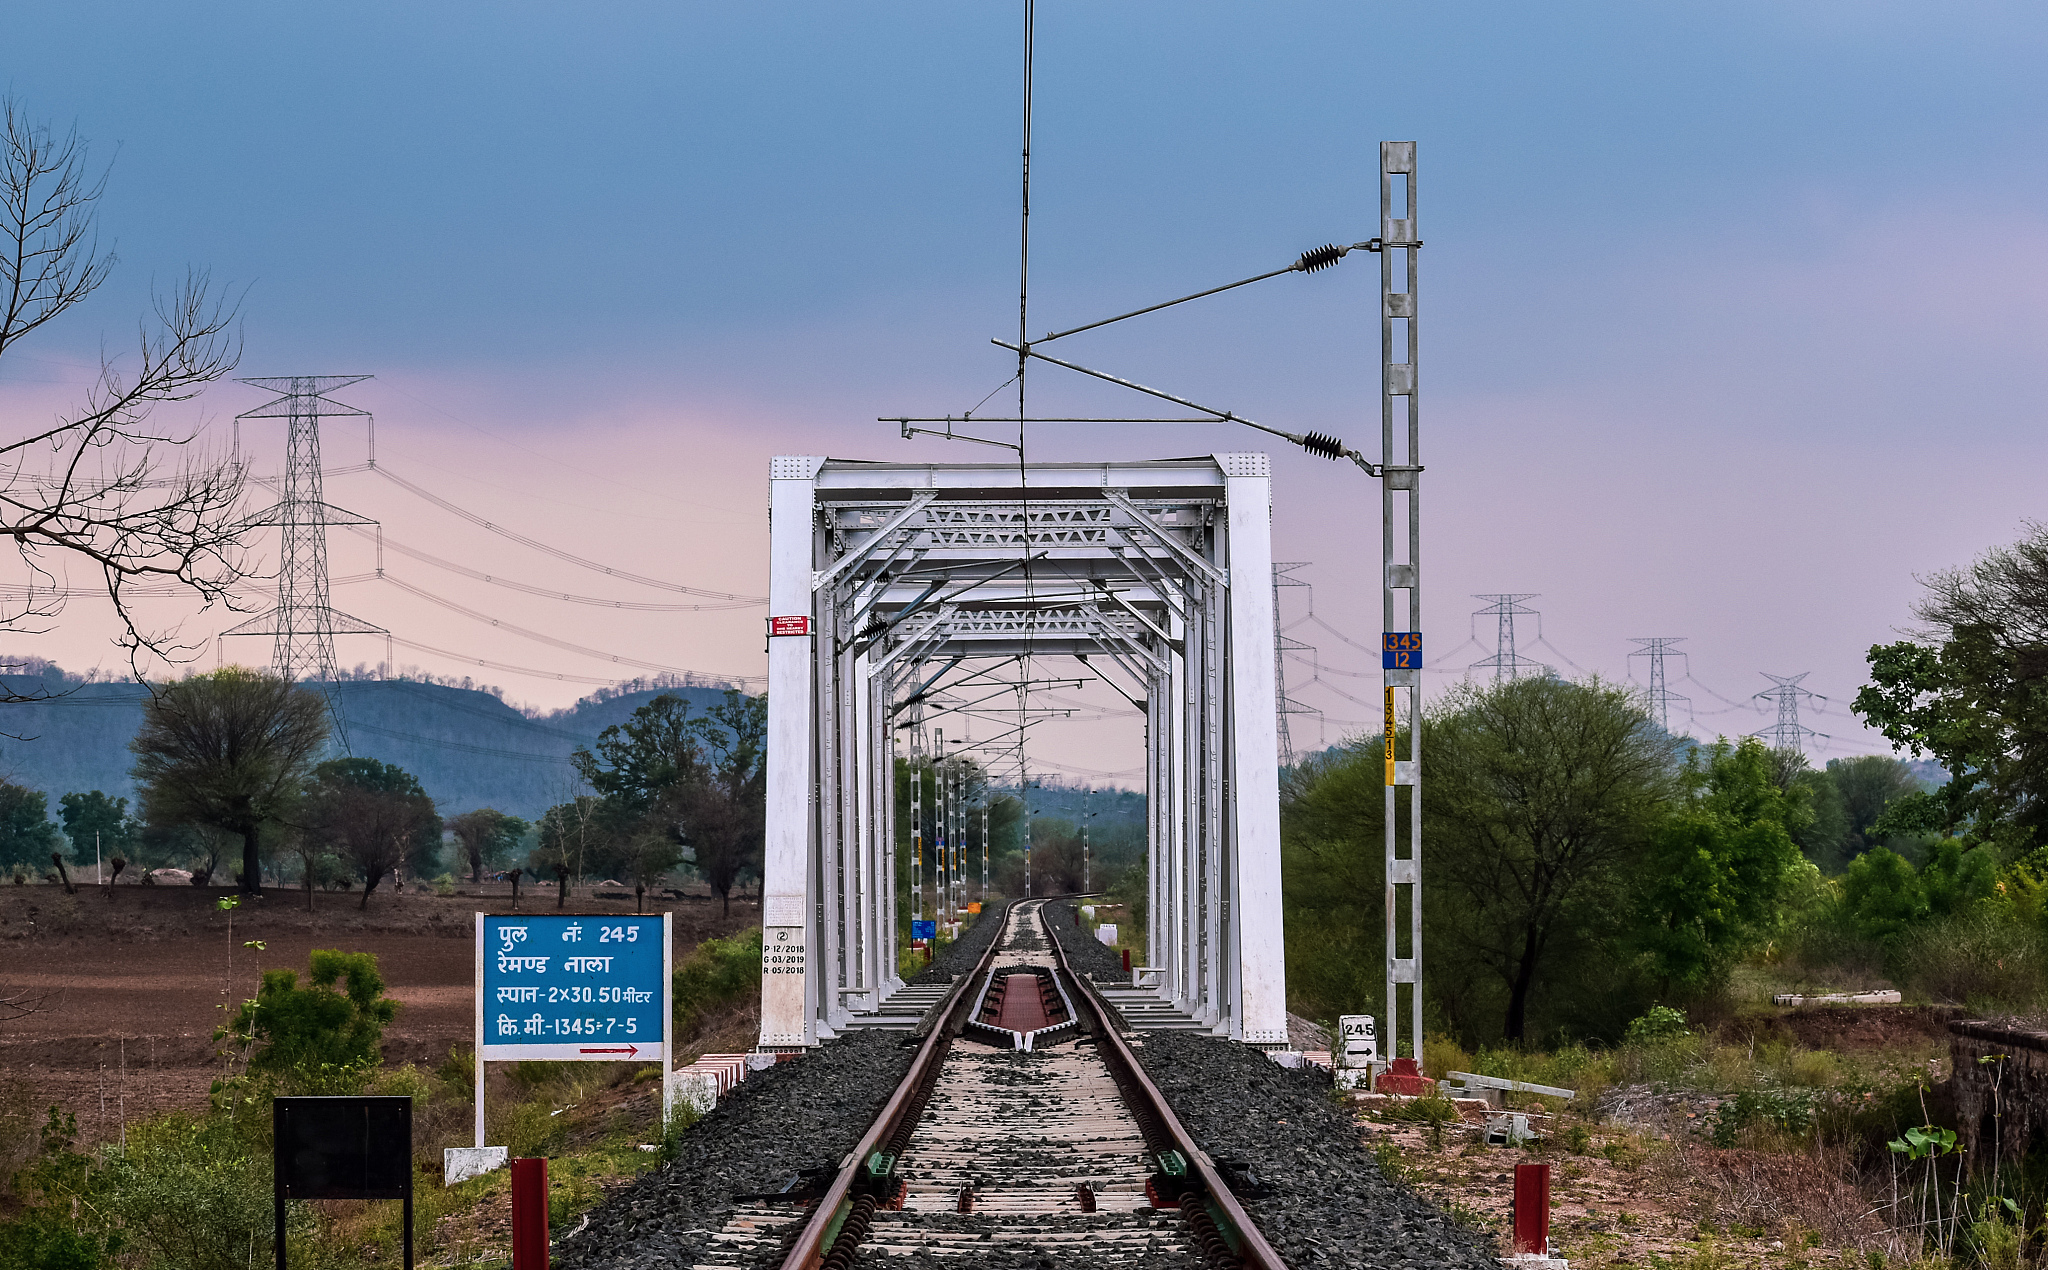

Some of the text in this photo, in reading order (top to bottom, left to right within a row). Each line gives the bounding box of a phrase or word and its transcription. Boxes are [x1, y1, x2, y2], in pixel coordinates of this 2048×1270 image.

[1383, 634, 1421, 650] 1345
[1395, 652, 1410, 667] 12
[497, 926, 528, 952] पुल
[599, 925, 640, 943] 245
[497, 951, 614, 974] रेमण्ड नाला
[1345, 1024, 1374, 1036] 245
